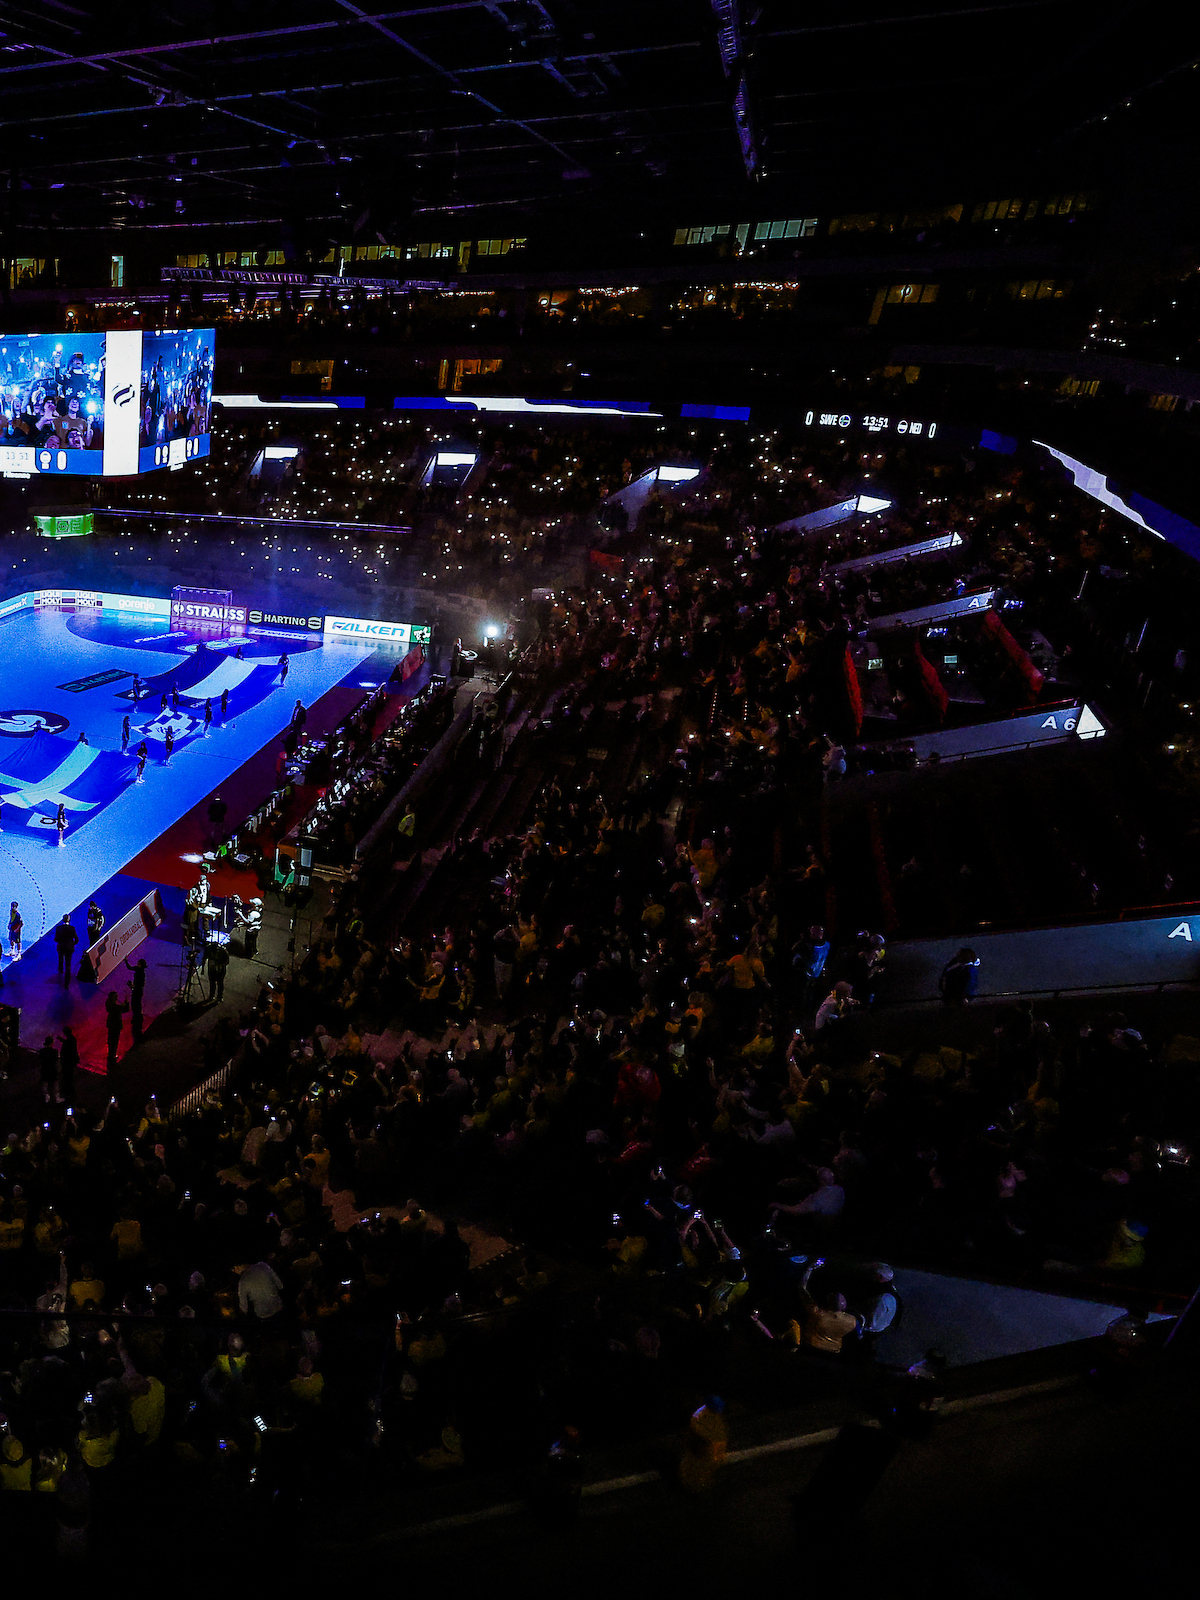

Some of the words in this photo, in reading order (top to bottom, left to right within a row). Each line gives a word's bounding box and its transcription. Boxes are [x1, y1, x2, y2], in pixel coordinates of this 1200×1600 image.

[805, 411, 813, 425] 0
[819, 414, 838, 426] SWE
[862, 416, 889, 428] 13:51
[909, 422, 922, 434] NED
[928, 423, 936, 438] 0
[118, 599, 156, 611] gorenje
[186, 604, 245, 621] STRAUSS
[264, 614, 306, 626] HARTING
[332, 621, 405, 637] FALKEN
[1041, 715, 1058, 730] A
[1063, 718, 1077, 731] 6
[1167, 922, 1193, 942] A
